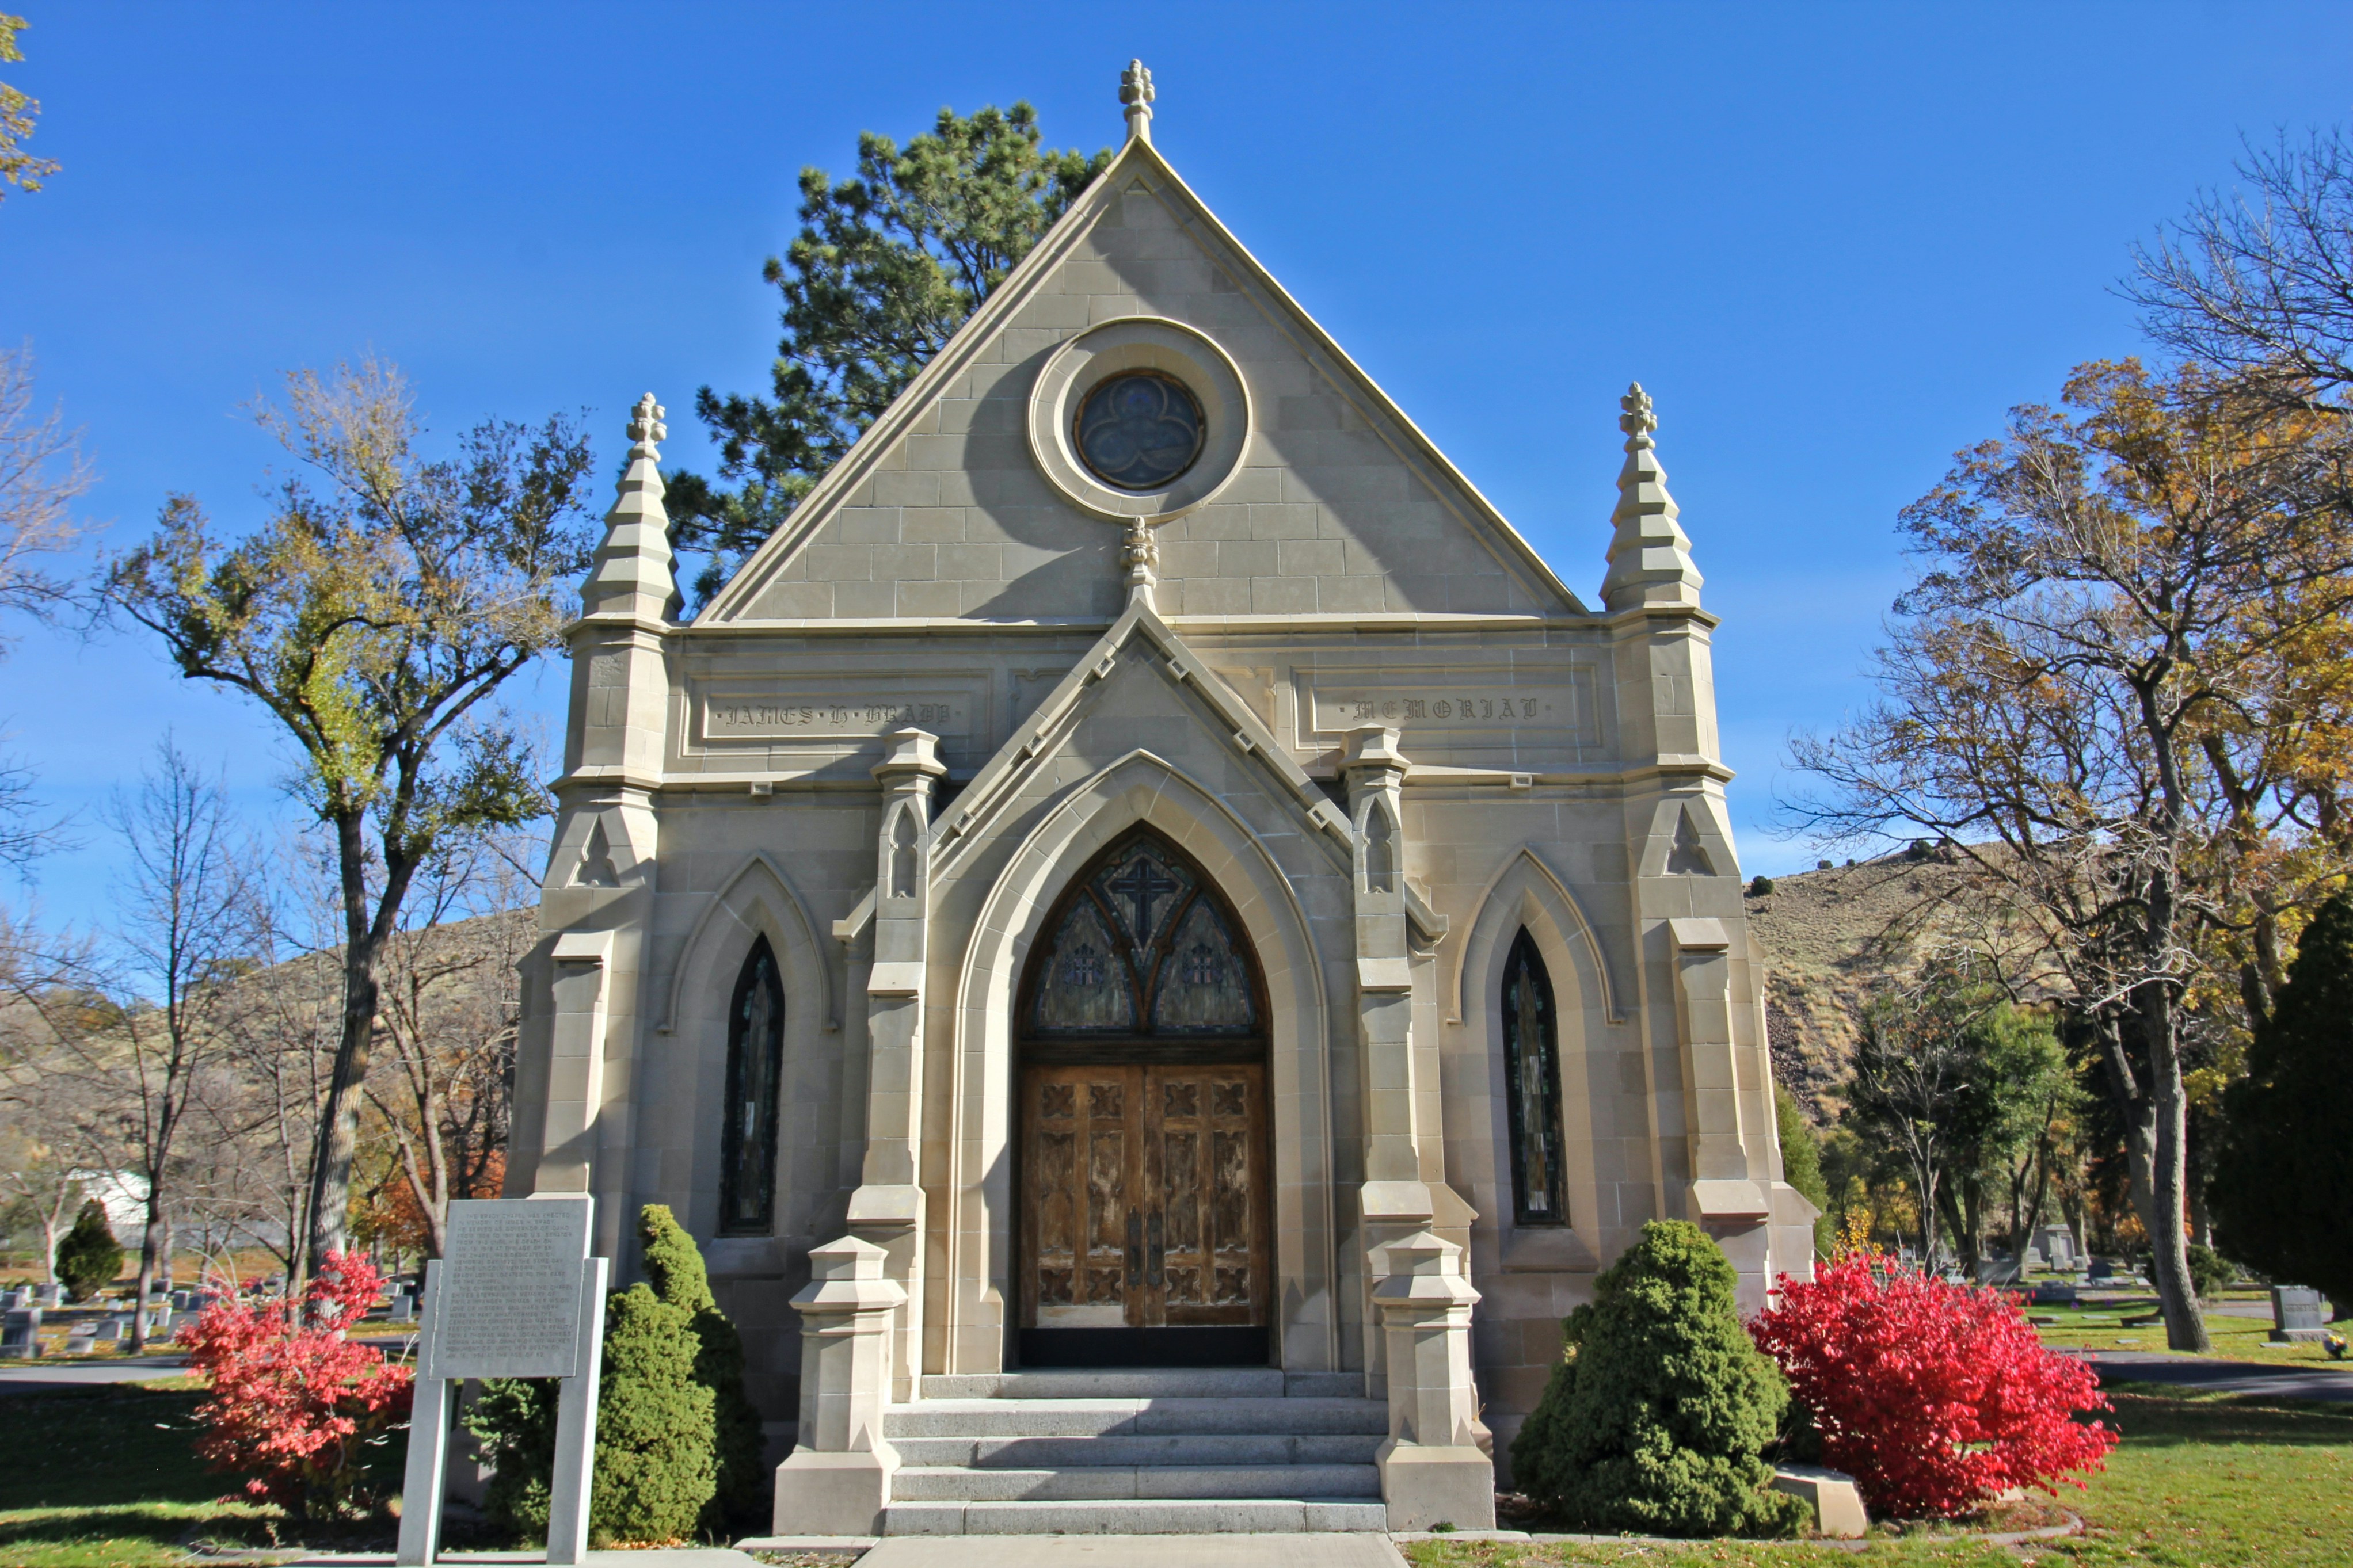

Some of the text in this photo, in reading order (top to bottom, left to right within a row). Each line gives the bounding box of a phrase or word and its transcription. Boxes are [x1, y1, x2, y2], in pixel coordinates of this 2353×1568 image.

[725, 704, 813, 727] JAMES
[864, 704, 951, 727] BRADY
[1352, 698, 1537, 721] MEMORIAL
